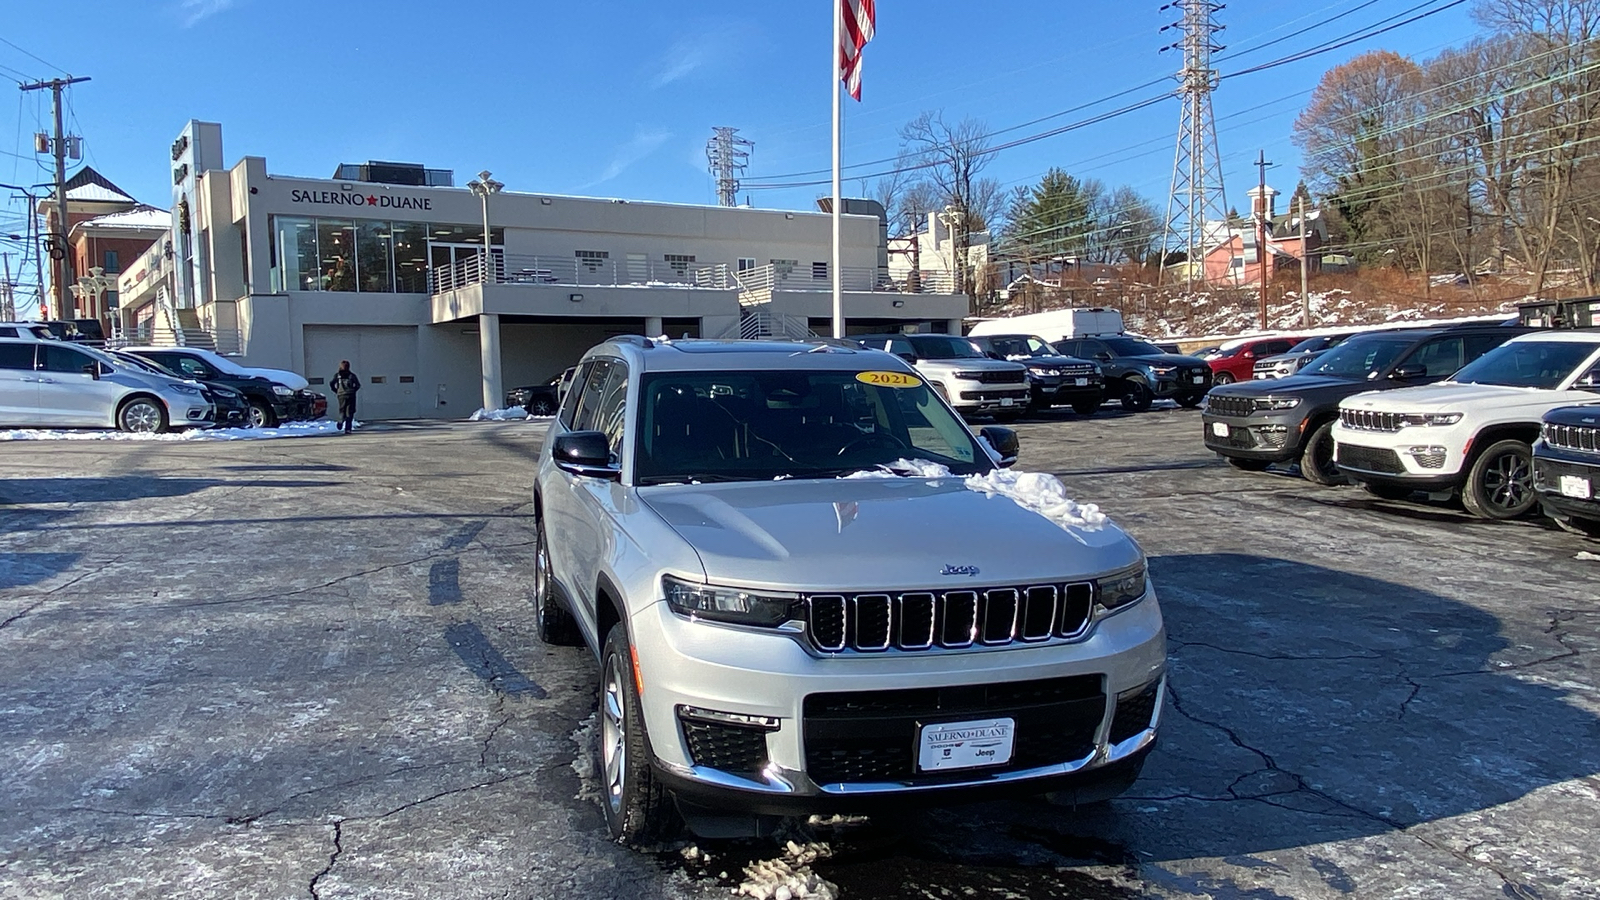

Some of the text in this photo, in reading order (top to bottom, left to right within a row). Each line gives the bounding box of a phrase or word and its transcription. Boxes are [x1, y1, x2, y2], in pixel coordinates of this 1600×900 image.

[291, 190, 432, 211] SALERNO DUANE
[870, 374, 908, 384] 2021
[939, 563, 980, 577] Jeep
[927, 727, 1008, 742] SALERNO DUANE
[975, 749, 995, 757] Jeep
